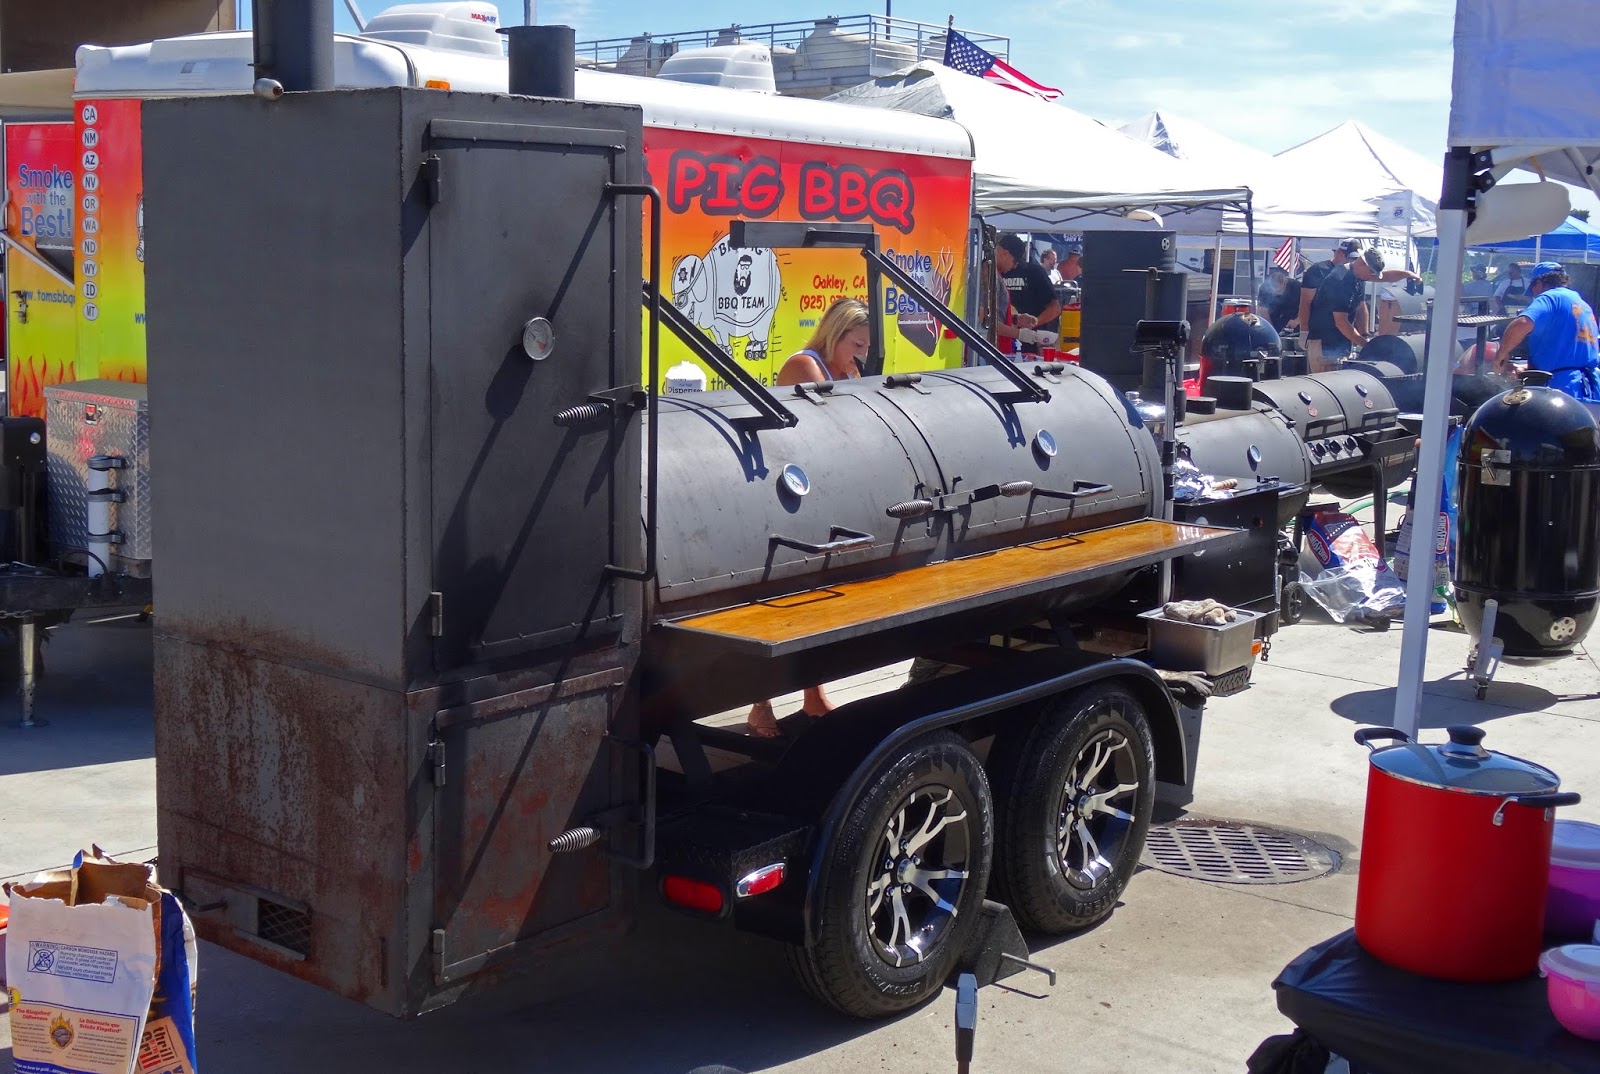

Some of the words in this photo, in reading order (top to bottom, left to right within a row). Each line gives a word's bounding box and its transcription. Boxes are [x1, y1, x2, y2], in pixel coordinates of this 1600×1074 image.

[84, 109, 96, 121] CA
[84, 132, 96, 144] NM
[84, 155, 96, 166] AZ
[19, 163, 73, 189] Smoke
[84, 178, 96, 189] NV
[26, 191, 46, 205] with
[49, 190, 66, 206] the
[670, 154, 783, 215] PIG
[801, 163, 912, 232] BBQ
[84, 200, 95, 210] OR
[21, 207, 72, 238] Best!
[84, 221, 97, 231] WA
[84, 243, 96, 254] ND
[886, 249, 932, 272] Smoke
[84, 265, 96, 275] WY
[85, 285, 95, 296] ID
[812, 274, 848, 293] Oakley,
[852, 275, 866, 289] CA
[718, 296, 738, 312] BBQ
[741, 296, 765, 309] TEAM
[800, 294, 826, 312] (925)
[885, 286, 928, 316] Bes
[86, 306, 96, 317] MT
[152, 1026, 175, 1062] thrill
